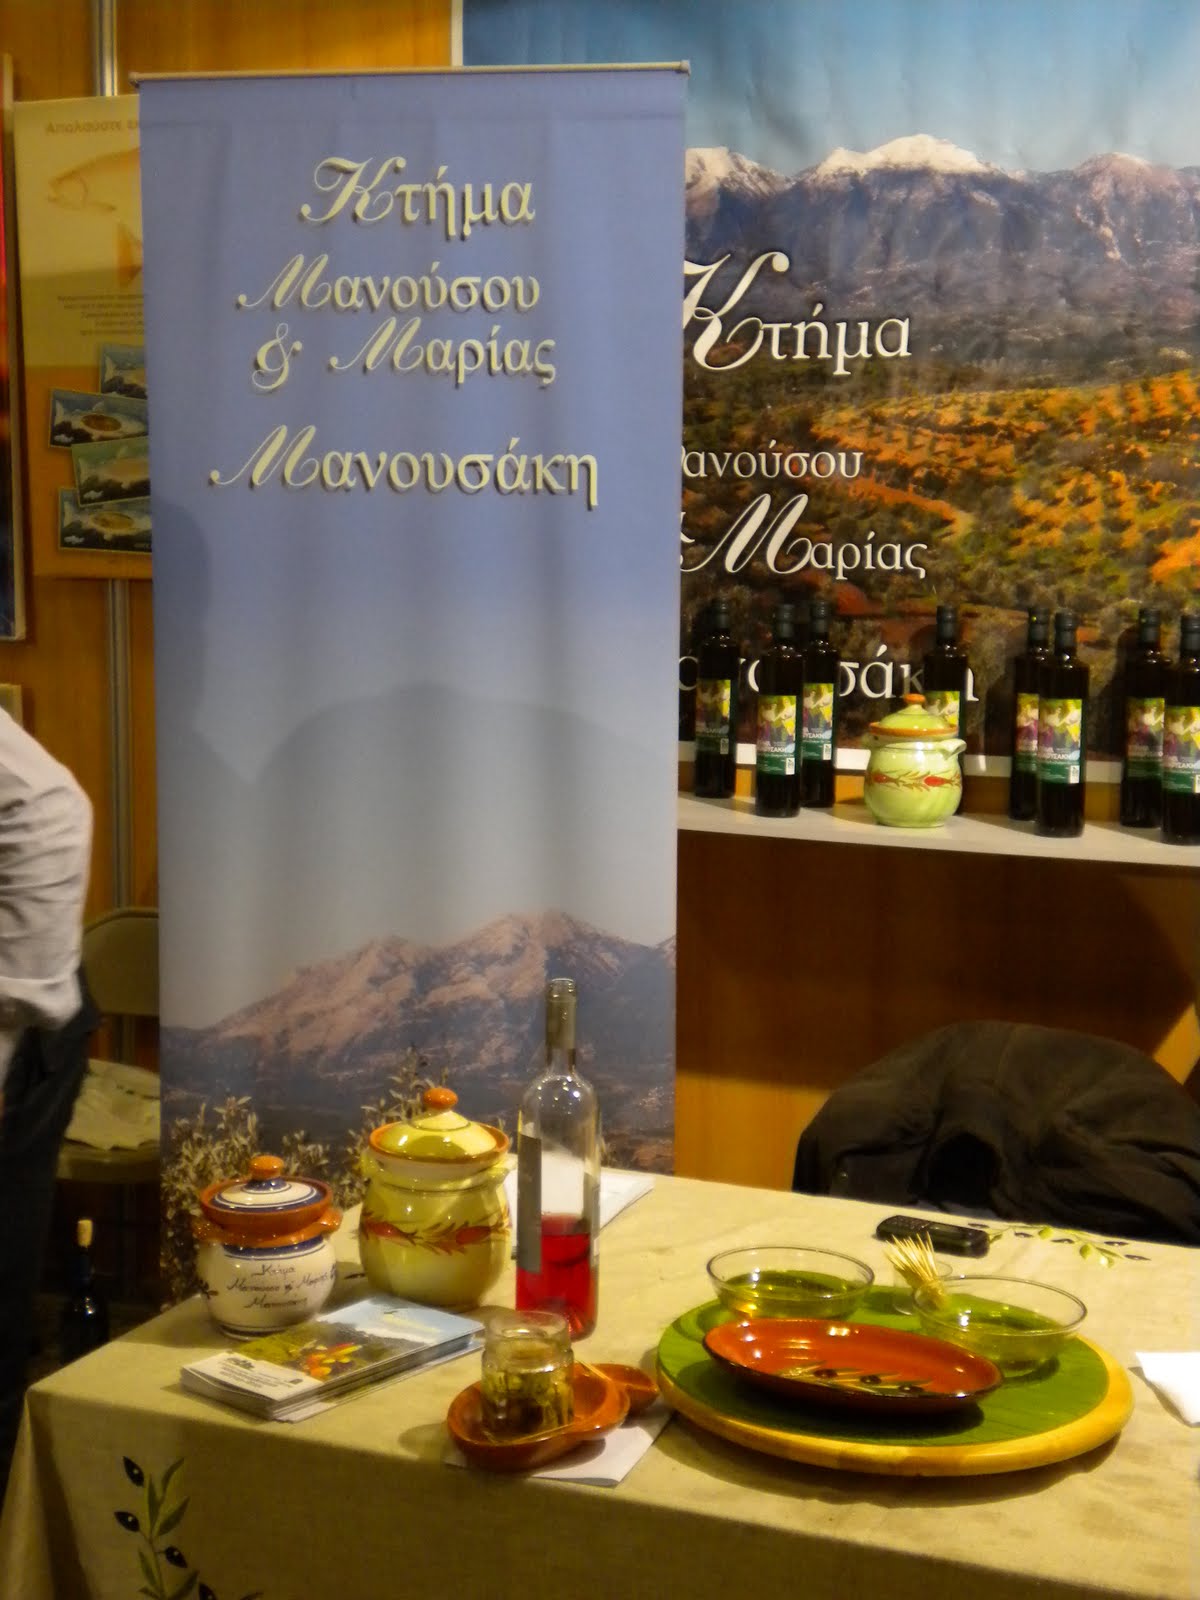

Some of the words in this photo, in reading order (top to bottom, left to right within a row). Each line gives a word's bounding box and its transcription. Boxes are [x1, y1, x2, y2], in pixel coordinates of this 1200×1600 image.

[299, 156, 536, 239] Κτήμα
[237, 253, 541, 310] Μανούσου
[252, 322, 302, 390] &
[330, 316, 557, 386] Μαρίας
[209, 424, 600, 508] Μανουσάκη
[681, 440, 863, 478] ανούσου
[680, 493, 928, 580] Μαρίας
